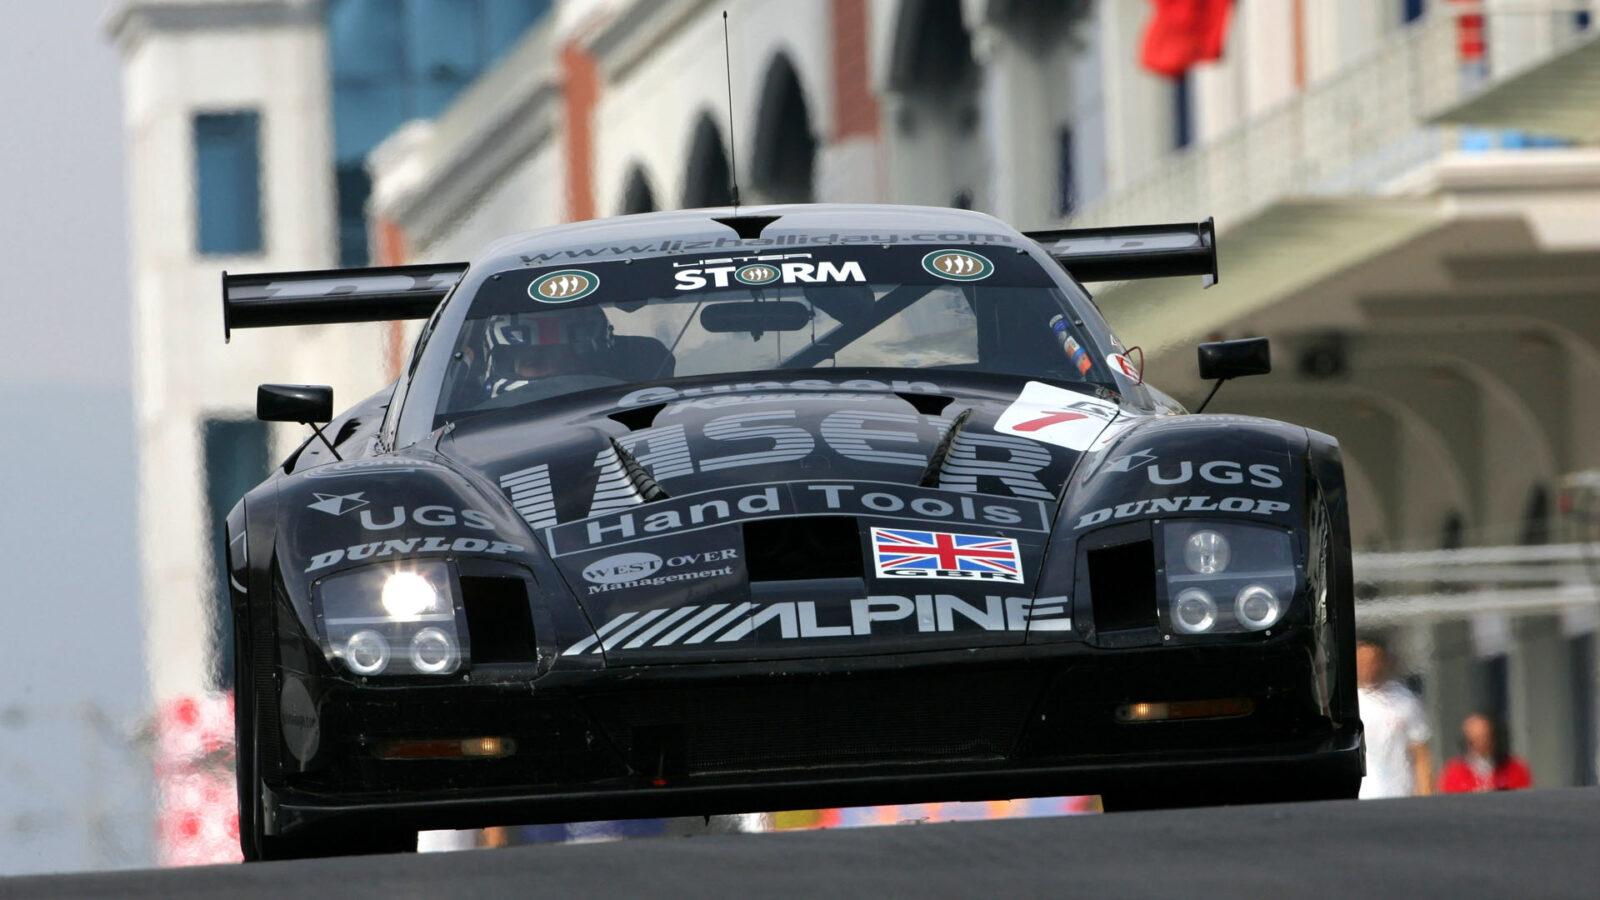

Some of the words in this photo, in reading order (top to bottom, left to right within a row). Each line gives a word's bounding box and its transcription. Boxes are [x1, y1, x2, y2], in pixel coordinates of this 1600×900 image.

[520, 233, 1012, 264] www.lizhalliday.com
[500, 409, 1057, 531] LASER
[1147, 460, 1283, 489] UGS
[359, 505, 496, 531] UGS
[586, 487, 781, 545] Hand
[807, 484, 1023, 525] Tools
[1073, 495, 1291, 530] DUNLOP
[304, 536, 525, 573] DUNLOP
[588, 565, 734, 595] Management
[882, 568, 1020, 581] GBR
[715, 594, 1072, 643] ALPINE
